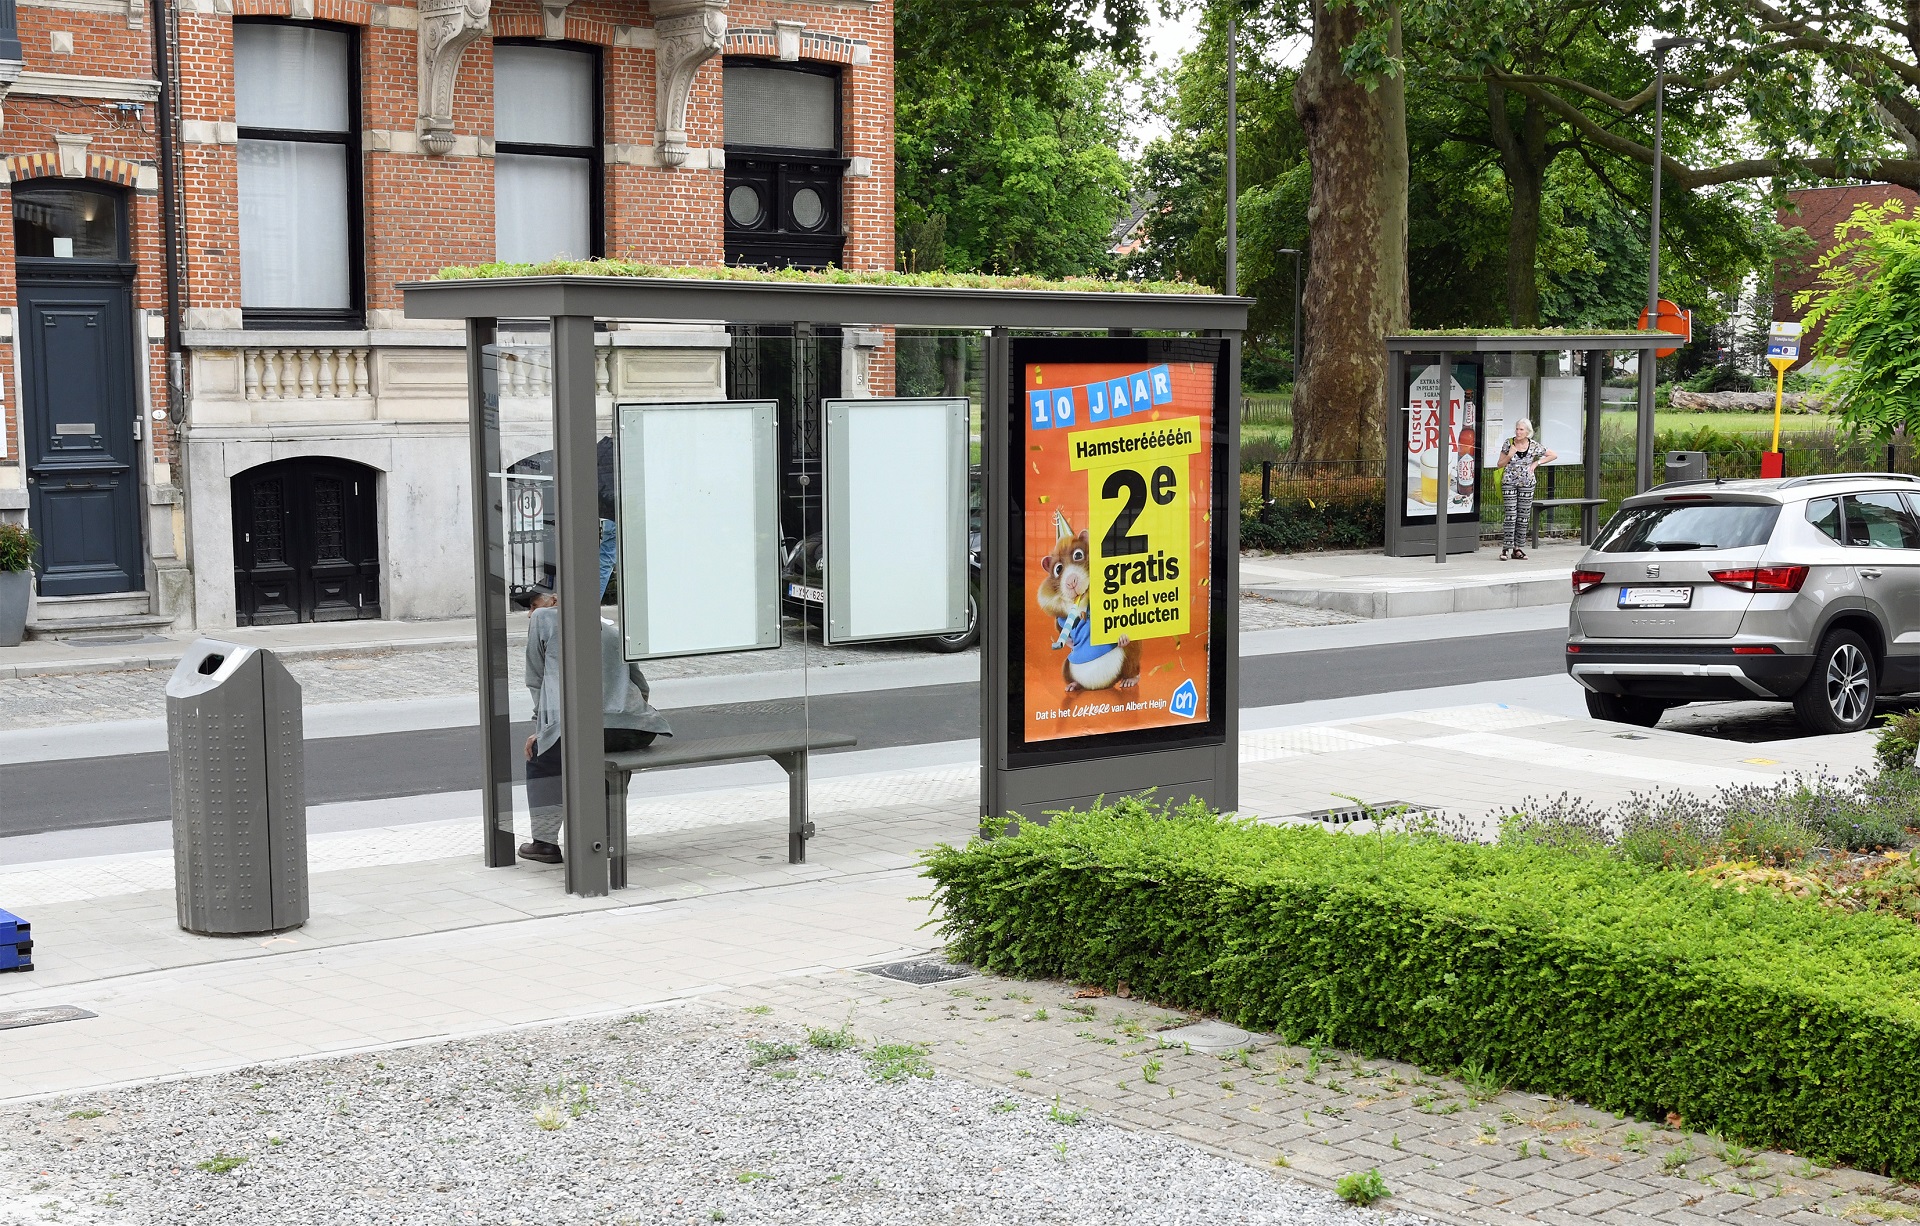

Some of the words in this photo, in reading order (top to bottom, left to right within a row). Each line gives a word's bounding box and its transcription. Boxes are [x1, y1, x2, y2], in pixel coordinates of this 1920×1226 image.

[1035, 396, 1071, 423] 10
[1092, 373, 1169, 414] JAAR
[1076, 428, 1192, 459] Hamsterééééén
[1103, 550, 1180, 594] gratis
[1103, 598, 1119, 612] op
[1123, 590, 1149, 608] heel
[1152, 587, 1179, 602] veel
[1104, 606, 1180, 633] producten
[1035, 710, 1049, 720] Dat
[1050, 709, 1057, 719] is
[1058, 708, 1071, 718] het
[1111, 704, 1124, 713] van
[1125, 700, 1148, 712] Albert
[1148, 698, 1167, 709] Heijn
